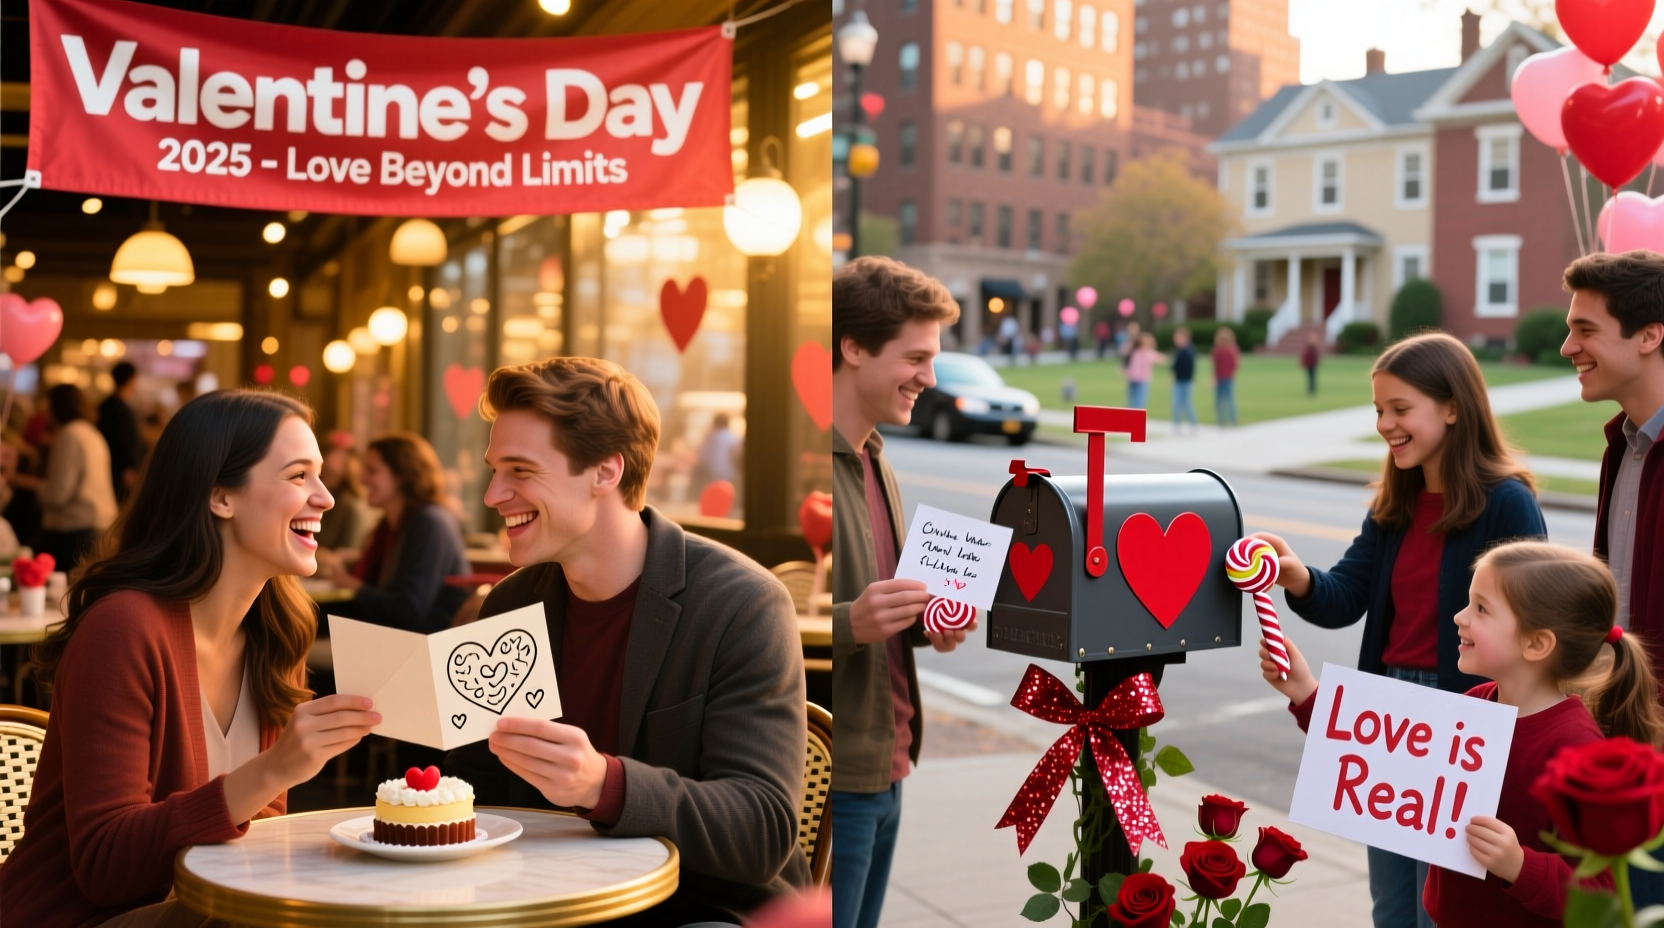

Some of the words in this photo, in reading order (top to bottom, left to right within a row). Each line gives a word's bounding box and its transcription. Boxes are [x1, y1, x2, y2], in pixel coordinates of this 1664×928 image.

[60, 34, 529, 142] Valentine's
[545, 68, 705, 157] Day
[156, 137, 252, 178] 2025
[287, 146, 372, 184] Love
[380, 151, 513, 196] Beyond
[522, 149, 629, 187] Limits
[1325, 684, 1433, 758] Love
[1448, 721, 1486, 772] is
[1332, 753, 1469, 840] Real!
